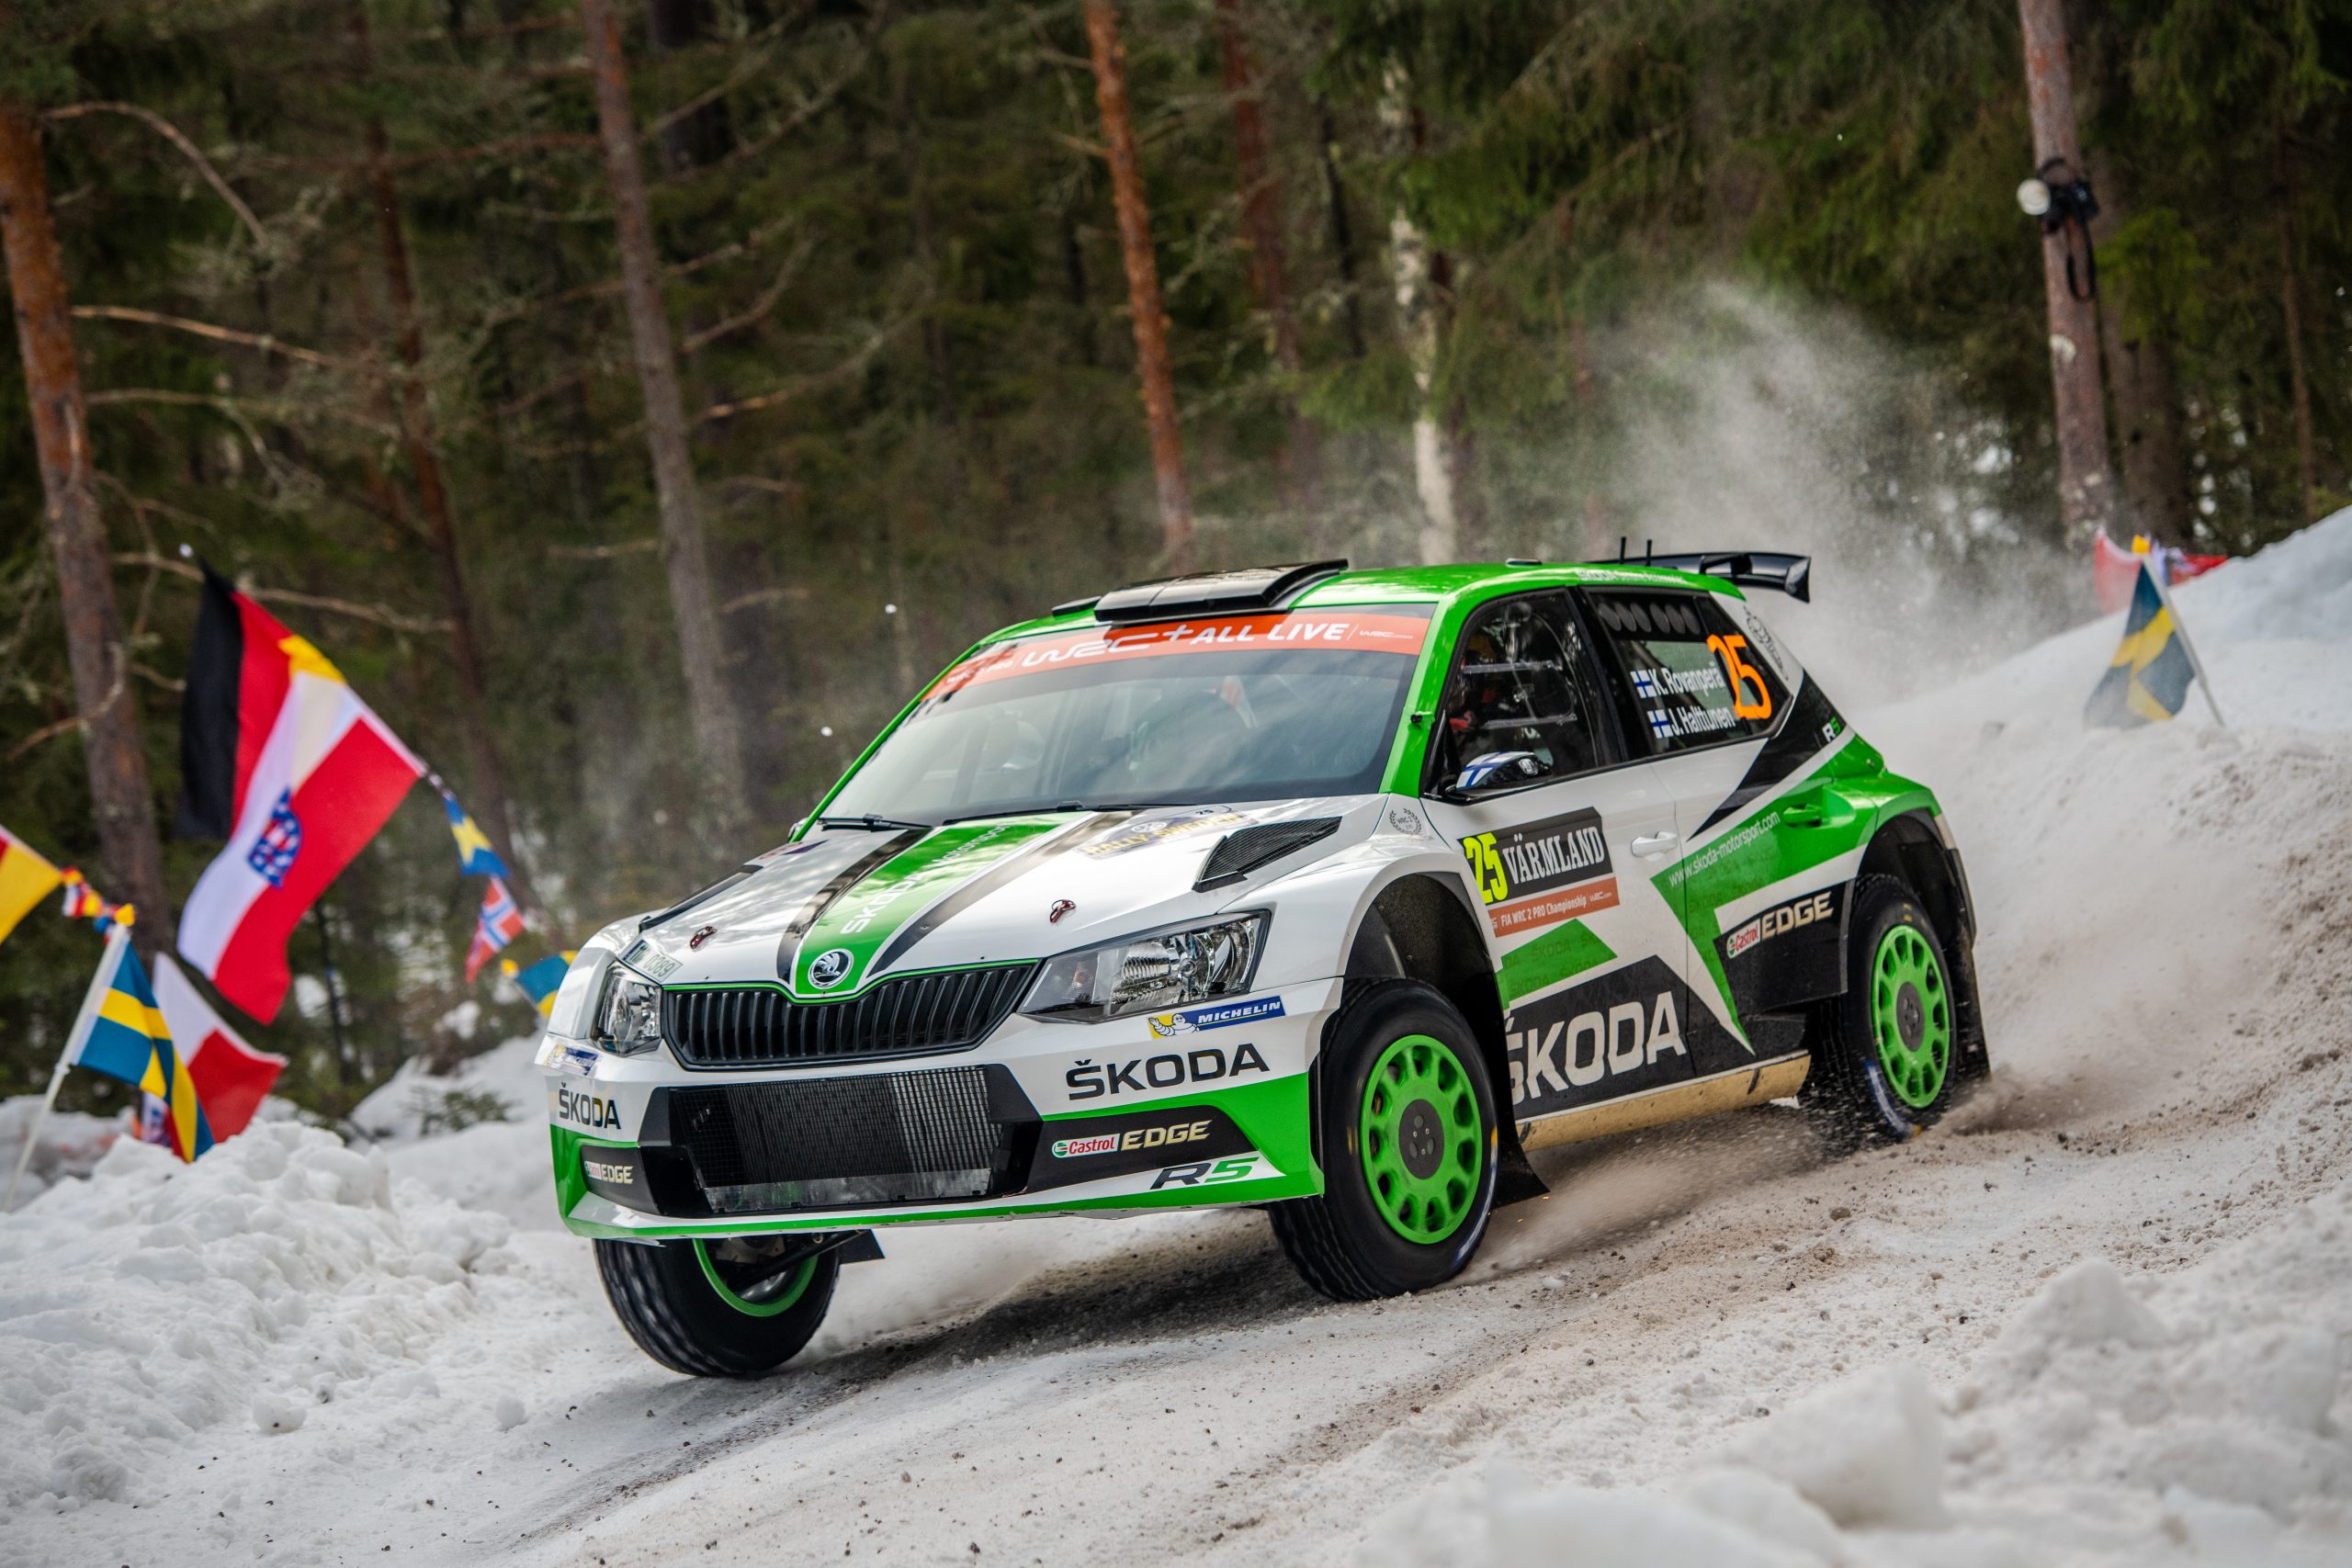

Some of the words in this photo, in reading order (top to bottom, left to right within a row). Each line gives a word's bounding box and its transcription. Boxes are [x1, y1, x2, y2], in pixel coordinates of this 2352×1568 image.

[1190, 625, 1253, 645] ALL
[1266, 624, 1350, 641] LIVE
[1647, 669, 1669, 696] K.
[1660, 660, 1727, 697] Rovanperä
[1706, 634, 1772, 719] 25
[1668, 708, 1684, 736] J.
[1676, 705, 1736, 735] Halttunen
[1082, 834, 1148, 855] RALLY
[1153, 813, 1242, 838] SWEDEN
[1668, 809, 1781, 887] www.skoda-motorsport.com
[1463, 832, 1509, 905] 25
[1502, 827, 1606, 885] VÄRMLAND
[1500, 913, 1512, 927] FIA
[1511, 909, 1527, 924] WRC
[1527, 908, 1532, 920] 2
[1532, 906, 1546, 919] PRO
[1546, 895, 1588, 915] Championship
[1734, 924, 1758, 952] Castrol
[1760, 891, 1835, 942] EDGE
[1197, 1001, 1282, 1024] MICHELIN
[1066, 1043, 1271, 1101] ŠKODA
[559, 1081, 621, 1130] ŠKODA
[1069, 1135, 1115, 1156] Castrol
[1121, 1119, 1214, 1152] EDGE
[601, 1163, 634, 1185] EDGE
[1149, 1156, 1260, 1190] R5
